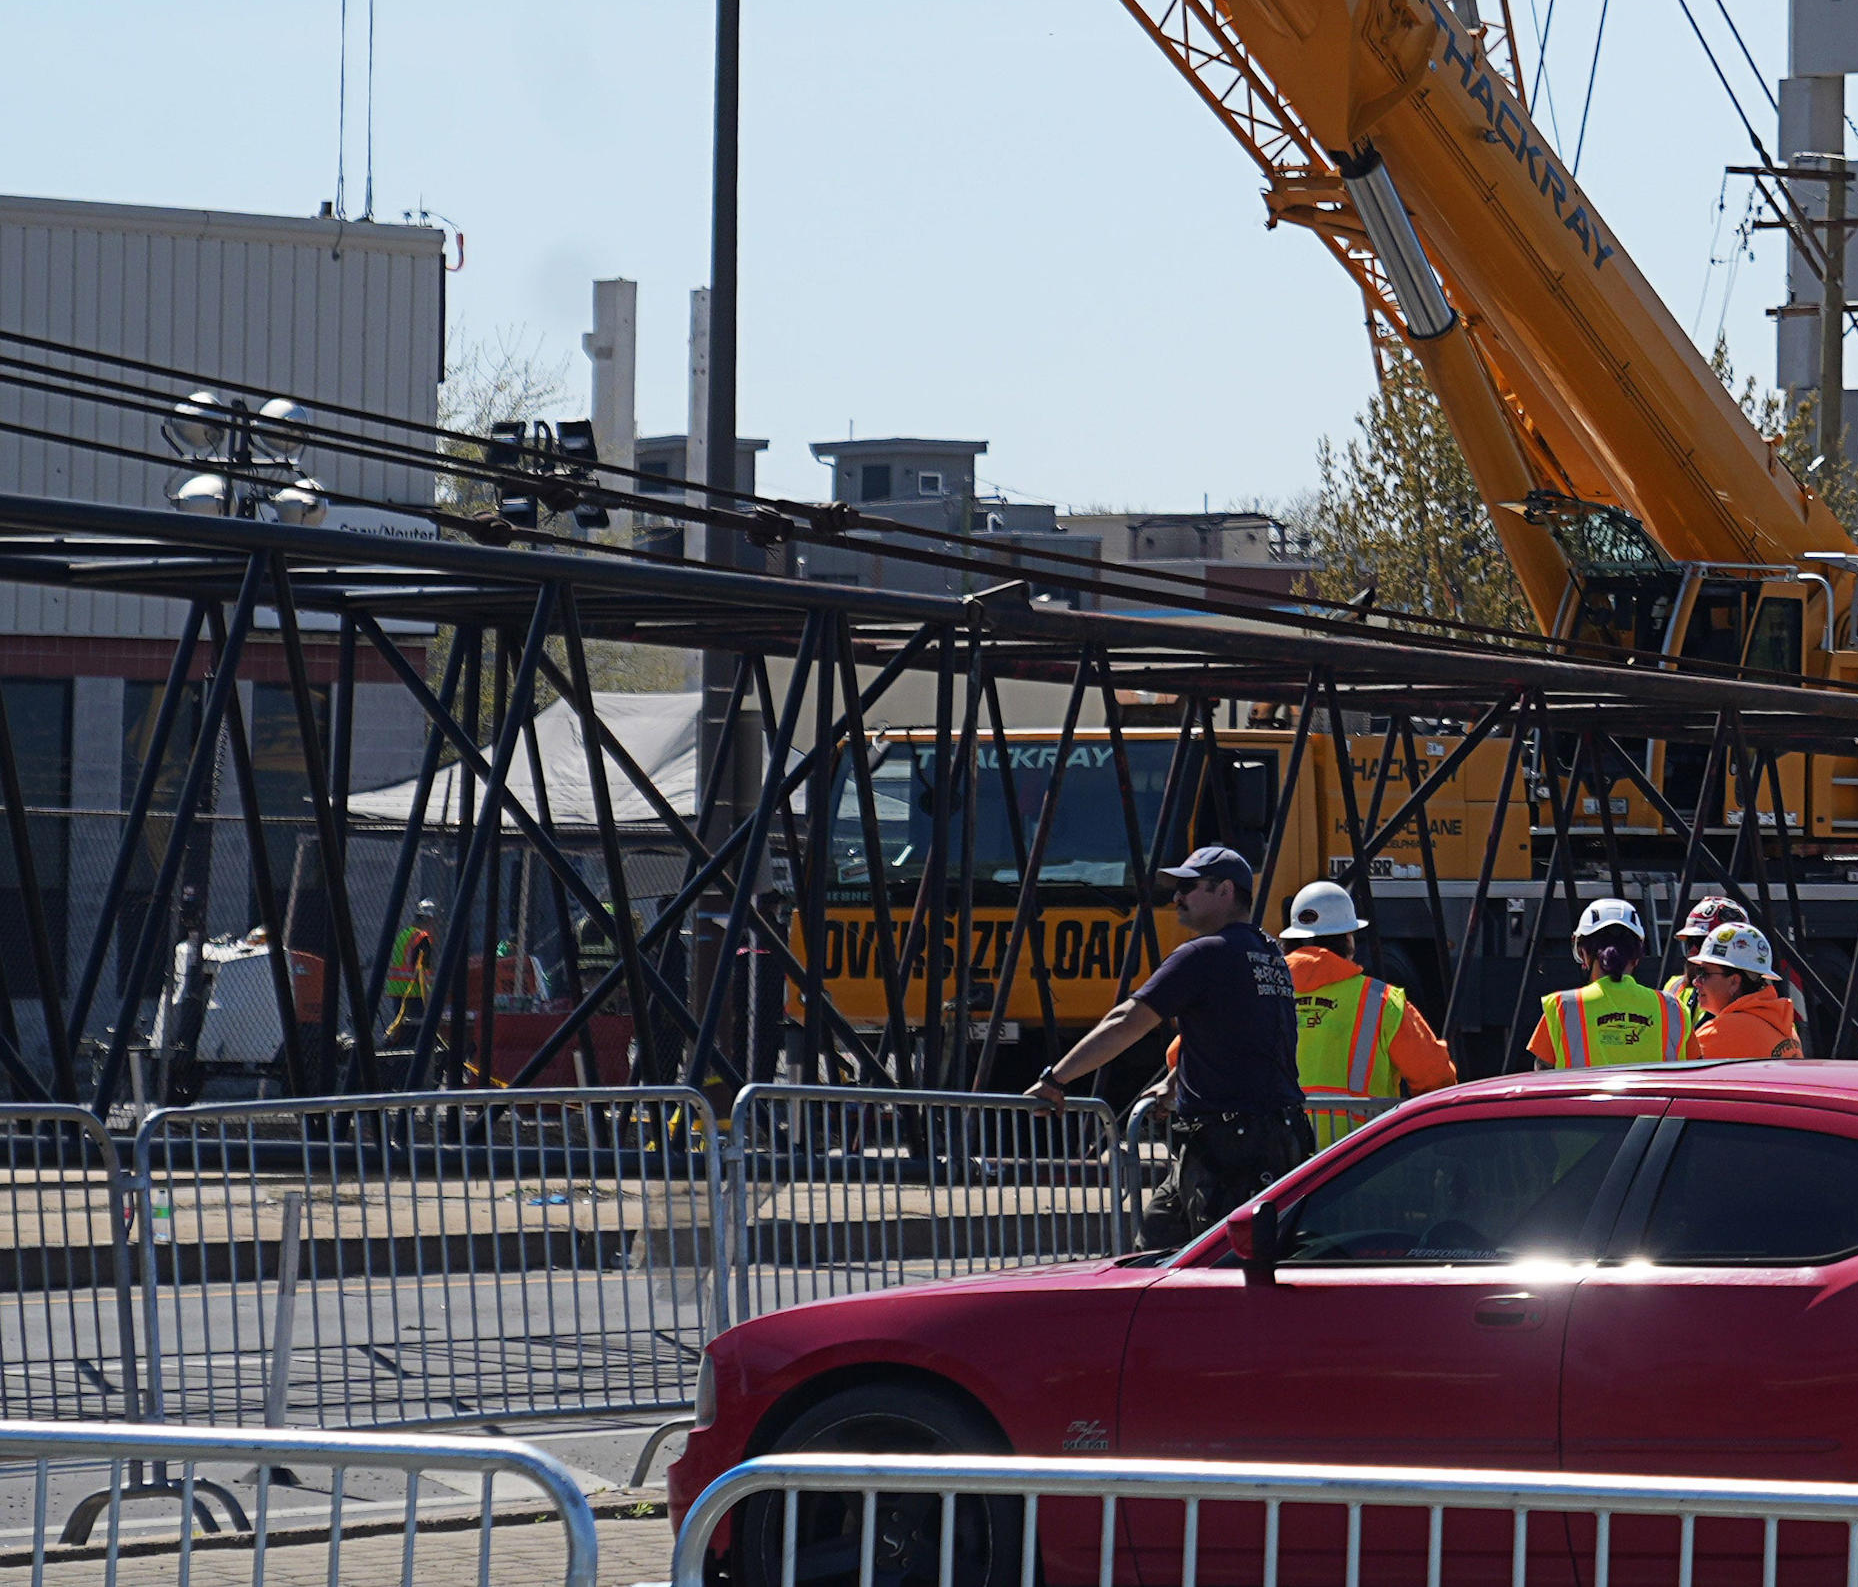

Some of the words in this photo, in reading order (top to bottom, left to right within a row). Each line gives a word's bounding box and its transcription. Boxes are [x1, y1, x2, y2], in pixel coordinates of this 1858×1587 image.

[1426, 0, 1614, 271] THACKRAY
[914, 748, 1113, 770] TACKRAY
[1330, 859, 1394, 879] LIEERR
[822, 918, 1015, 980] OVRSZE
[1029, 919, 1143, 980] LOAD
[1406, 1248, 1500, 1259] PERFORMAN
